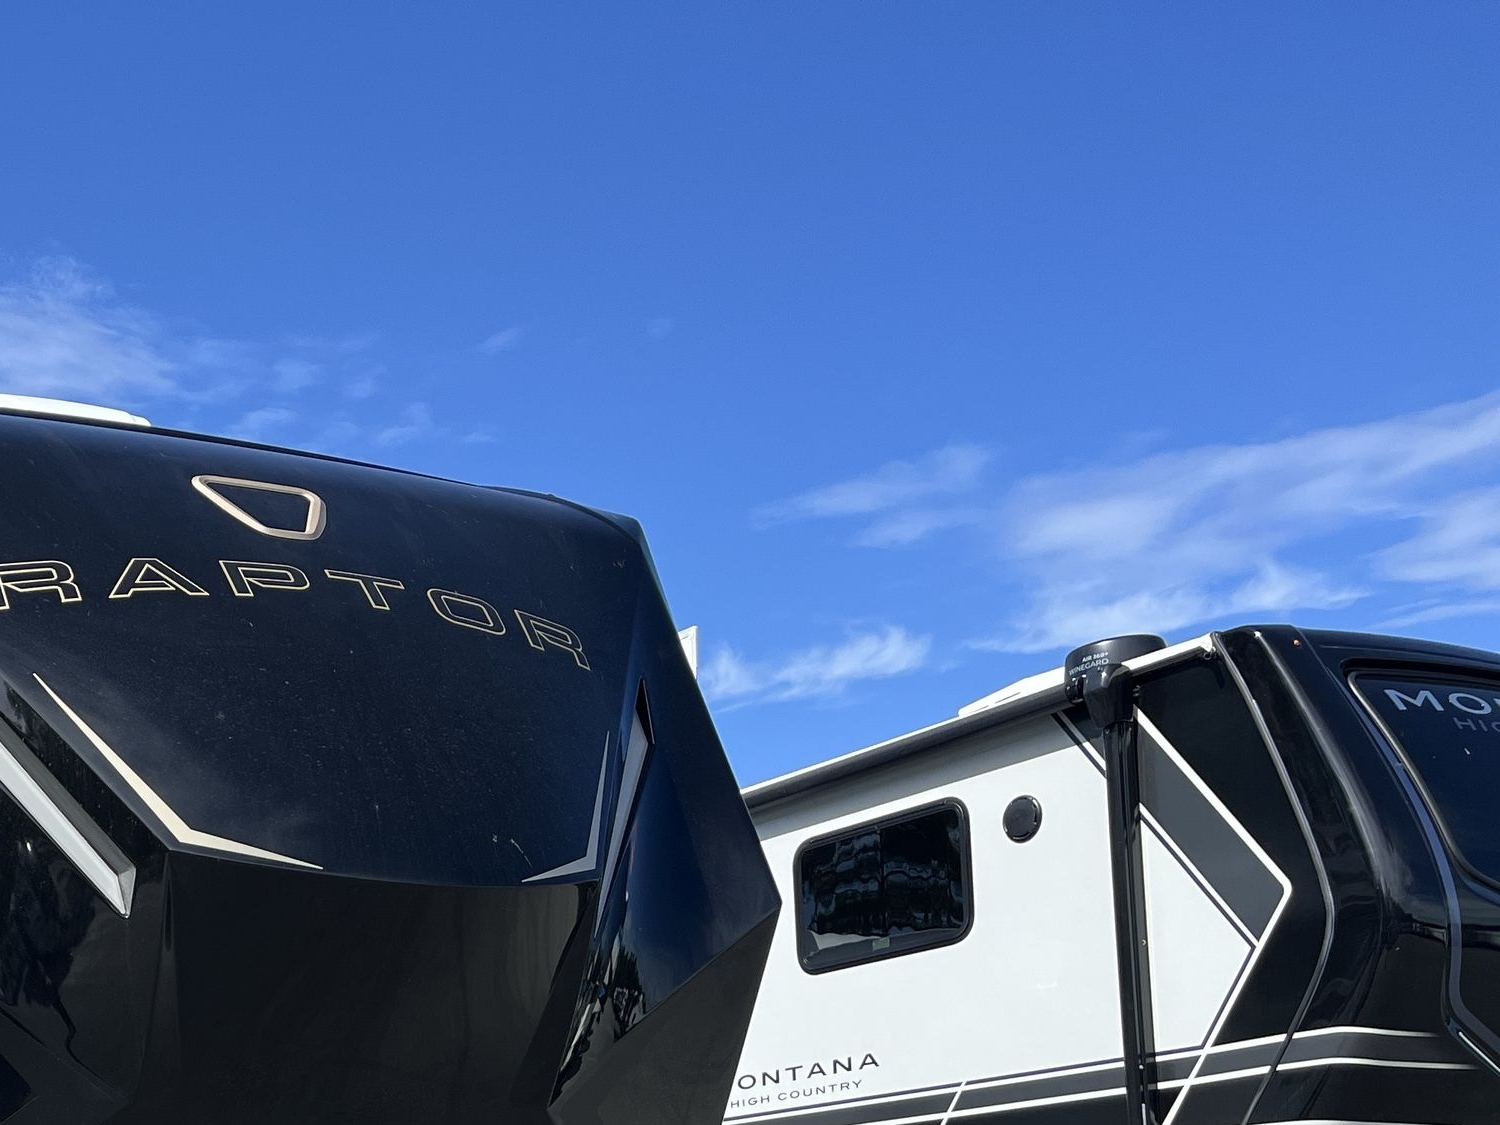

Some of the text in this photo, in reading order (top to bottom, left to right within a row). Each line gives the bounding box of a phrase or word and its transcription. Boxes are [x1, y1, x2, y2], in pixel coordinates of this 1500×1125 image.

[1068, 657, 1110, 676] WINEGARD
[1383, 688, 1500, 715] MO
[737, 1052, 880, 1091] ONTANA
[730, 1079, 863, 1109] HIGH COUNTRY
